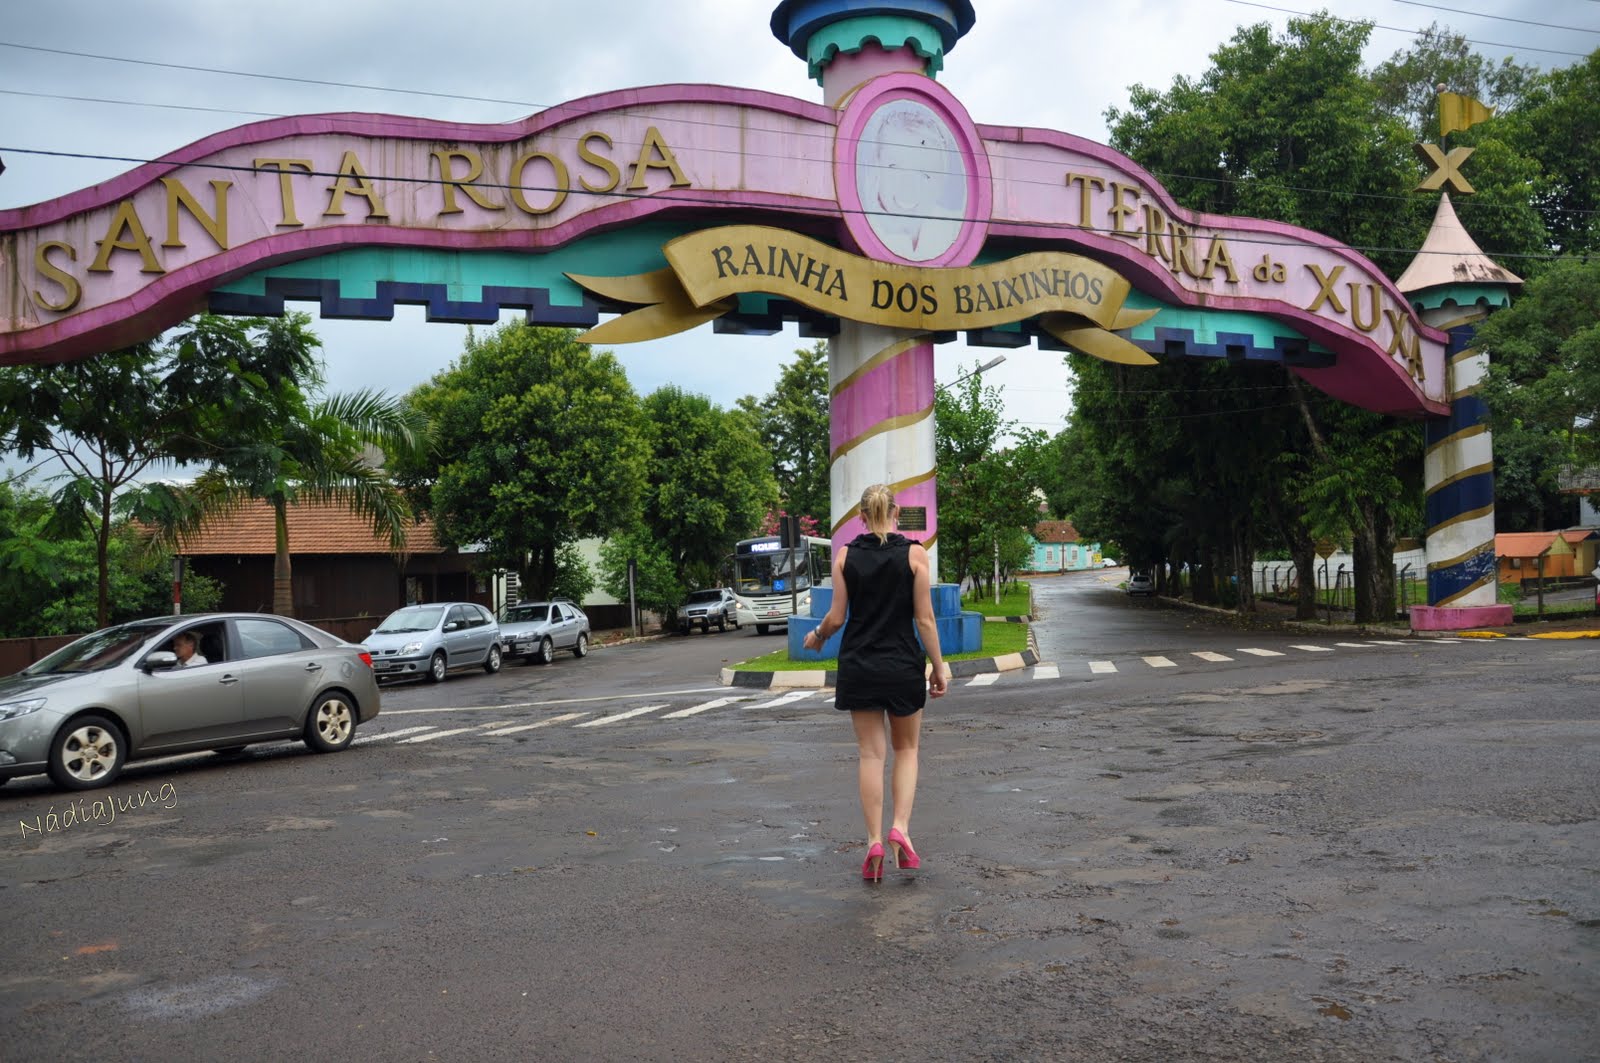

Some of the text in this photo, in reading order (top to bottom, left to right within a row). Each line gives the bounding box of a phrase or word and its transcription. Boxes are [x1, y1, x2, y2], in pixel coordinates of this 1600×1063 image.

[34, 126, 692, 312] SANTA ROSA
[712, 244, 1104, 314] RAINHA DOS BAIXINHOS
[1066, 173, 1425, 381] TERRA da XUXA
